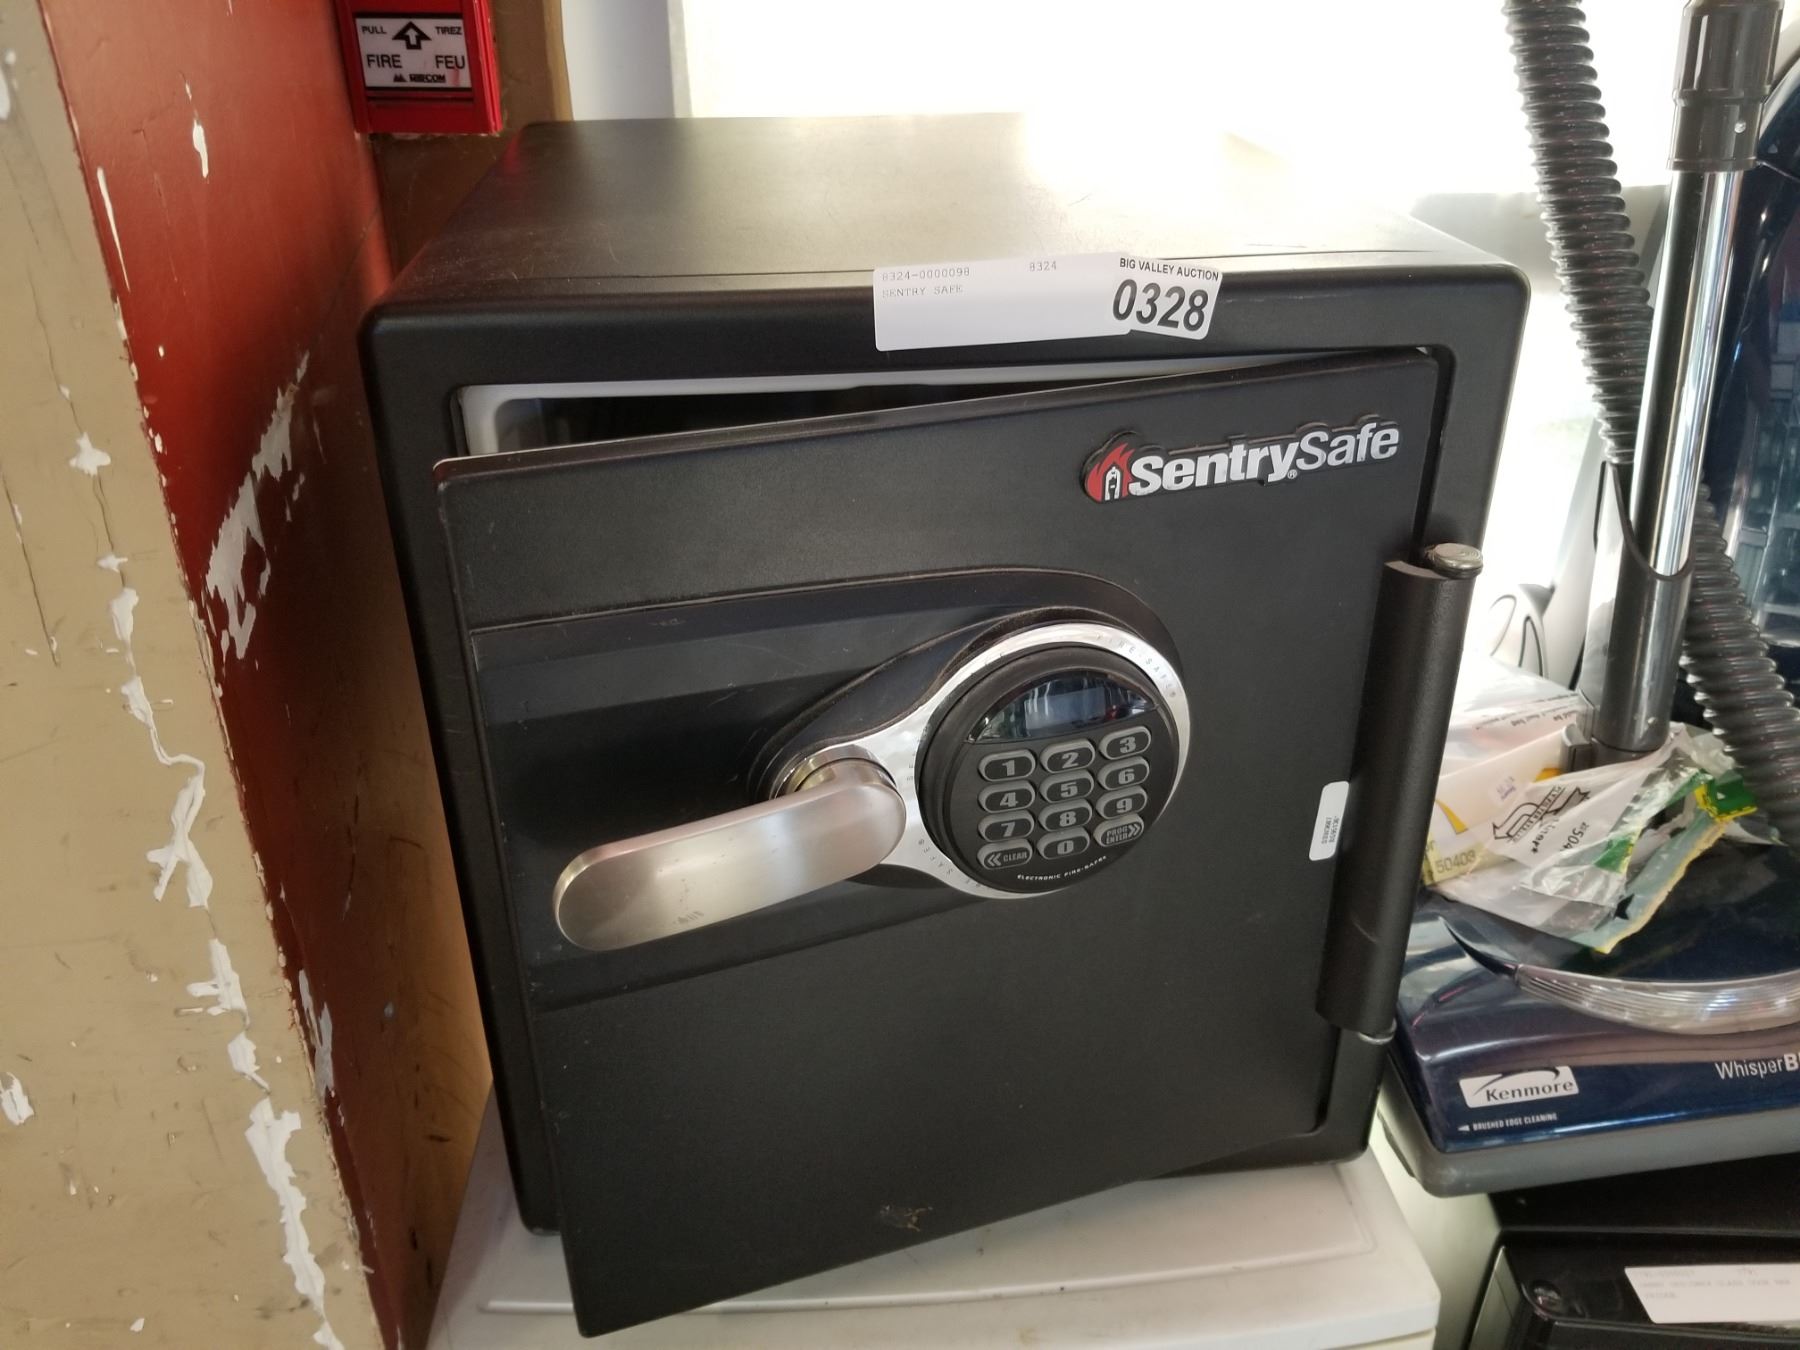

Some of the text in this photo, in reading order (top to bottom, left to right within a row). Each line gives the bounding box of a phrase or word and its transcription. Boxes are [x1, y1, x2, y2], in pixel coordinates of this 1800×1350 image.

[361, 26, 387, 35] PULL
[435, 26, 462, 35] TIREZ
[366, 54, 402, 69] FIRE
[435, 55, 466, 70] FEU
[882, 260, 1057, 281] 8324-0000098 8324
[1119, 257, 1219, 281] BIG VALLEY AUCTION
[882, 284, 963, 298] SENTRY SAFE
[1112, 279, 1209, 332] 0328
[1002, 736, 1136, 776] 1 2 3
[999, 769, 1135, 807] 4 5 6
[1001, 798, 1133, 837] 7 8 9
[1003, 840, 1074, 862] CLEAR 0
[1017, 873, 1061, 881] ELECTRONIC
[1714, 1052, 1800, 1080] WhisperB
[1486, 1080, 1574, 1102] Kenmore
[1472, 1112, 1557, 1131] BRUSHED EDGE CLEANING
